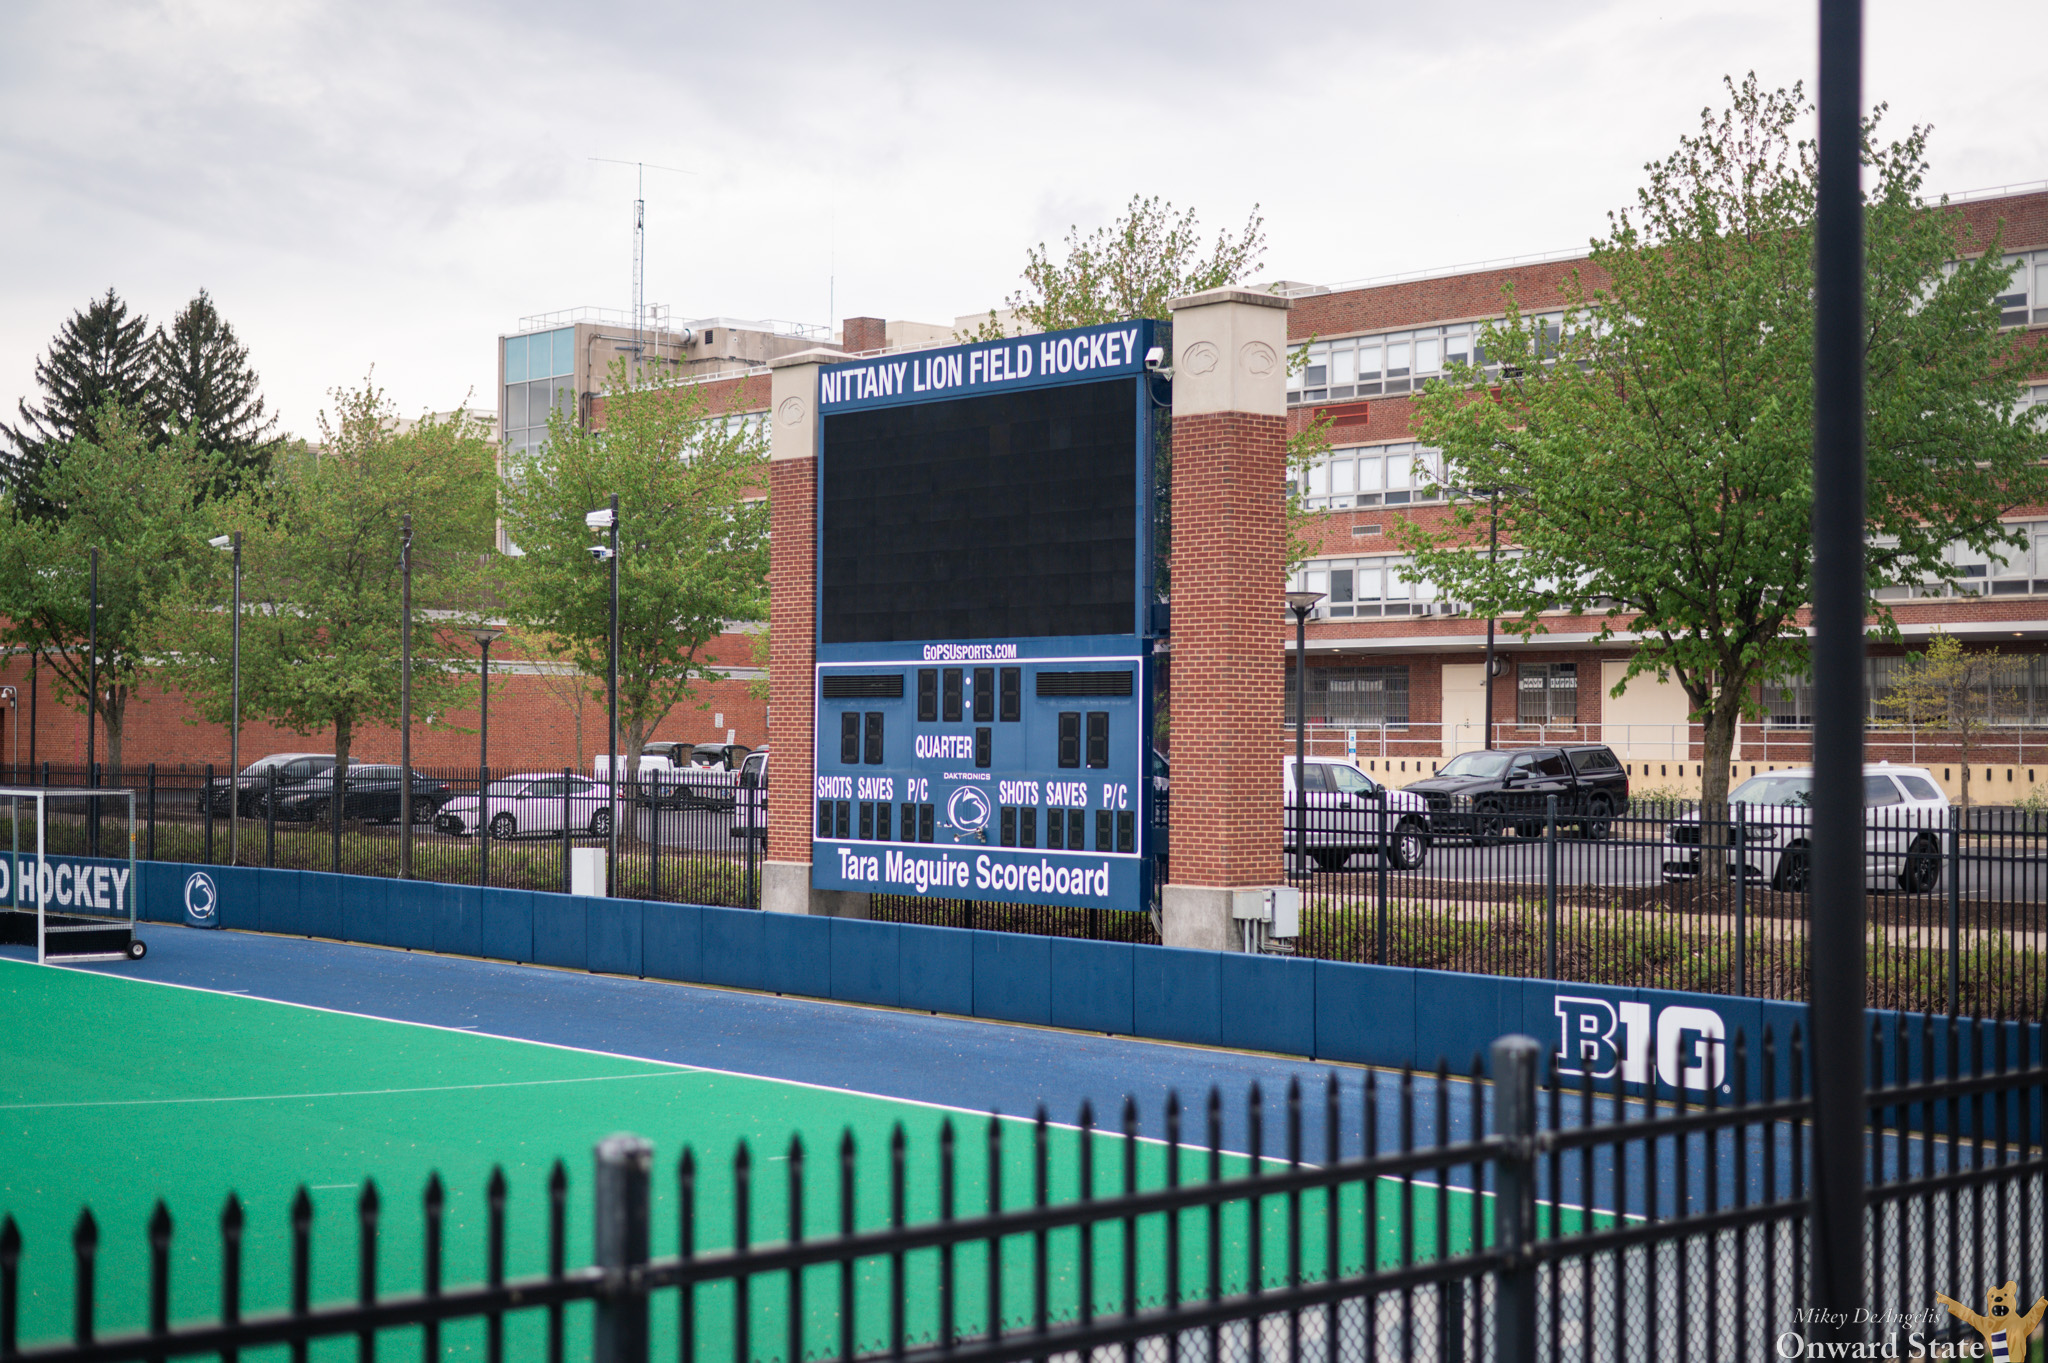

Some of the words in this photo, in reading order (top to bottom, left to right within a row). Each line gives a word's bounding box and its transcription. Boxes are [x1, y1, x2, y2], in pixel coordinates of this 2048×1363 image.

[821, 362, 908, 404] NITTANY
[913, 353, 963, 392] LION
[969, 344, 1033, 385] FIELD
[1040, 328, 1138, 375] HOCKEY
[915, 735, 973, 759] QUARTER
[817, 776, 853, 799] SHOTS
[857, 777, 893, 800] SAVES
[907, 778, 929, 803] P/C
[943, 772, 991, 780] DAKTRONICS
[999, 780, 1039, 806] SHOTS
[1045, 782, 1088, 807] SAVES
[1103, 783, 1128, 810] P/C
[18, 860, 130, 910] HOCKEY
[837, 848, 879, 882] Tara
[885, 850, 969, 893] Maguire
[976, 854, 1109, 897] Scoreboard
